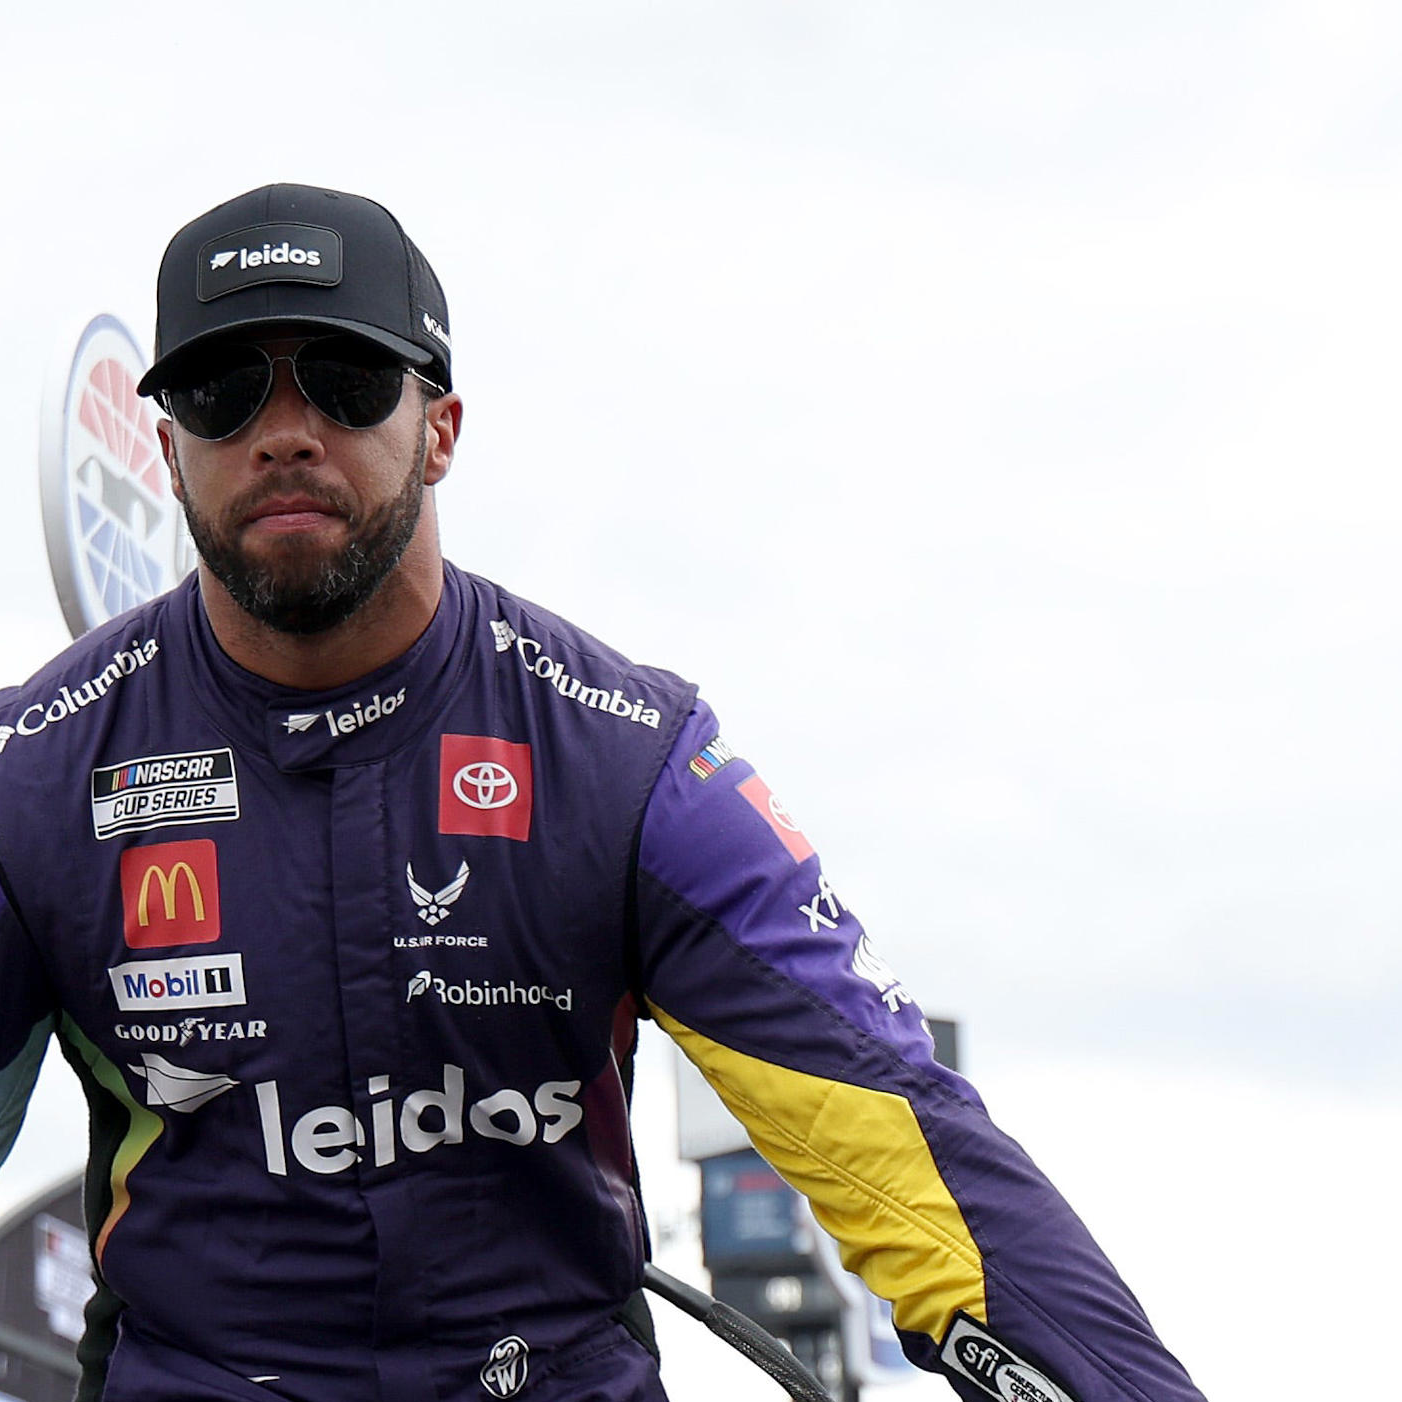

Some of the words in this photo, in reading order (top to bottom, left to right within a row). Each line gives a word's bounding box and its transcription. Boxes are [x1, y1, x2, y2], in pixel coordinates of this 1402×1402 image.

[240, 242, 321, 270] leidos
[15, 637, 160, 738] Columbia
[515, 635, 663, 730] Columbia
[325, 686, 407, 738] leidos
[135, 756, 215, 786] NASCAR
[112, 794, 150, 819] CUP
[151, 787, 217, 812] SERIES
[435, 935, 489, 948] FORCE
[122, 969, 201, 999] Mobil
[254, 1063, 584, 1177] leidos
[962, 1341, 1001, 1379] sfi
